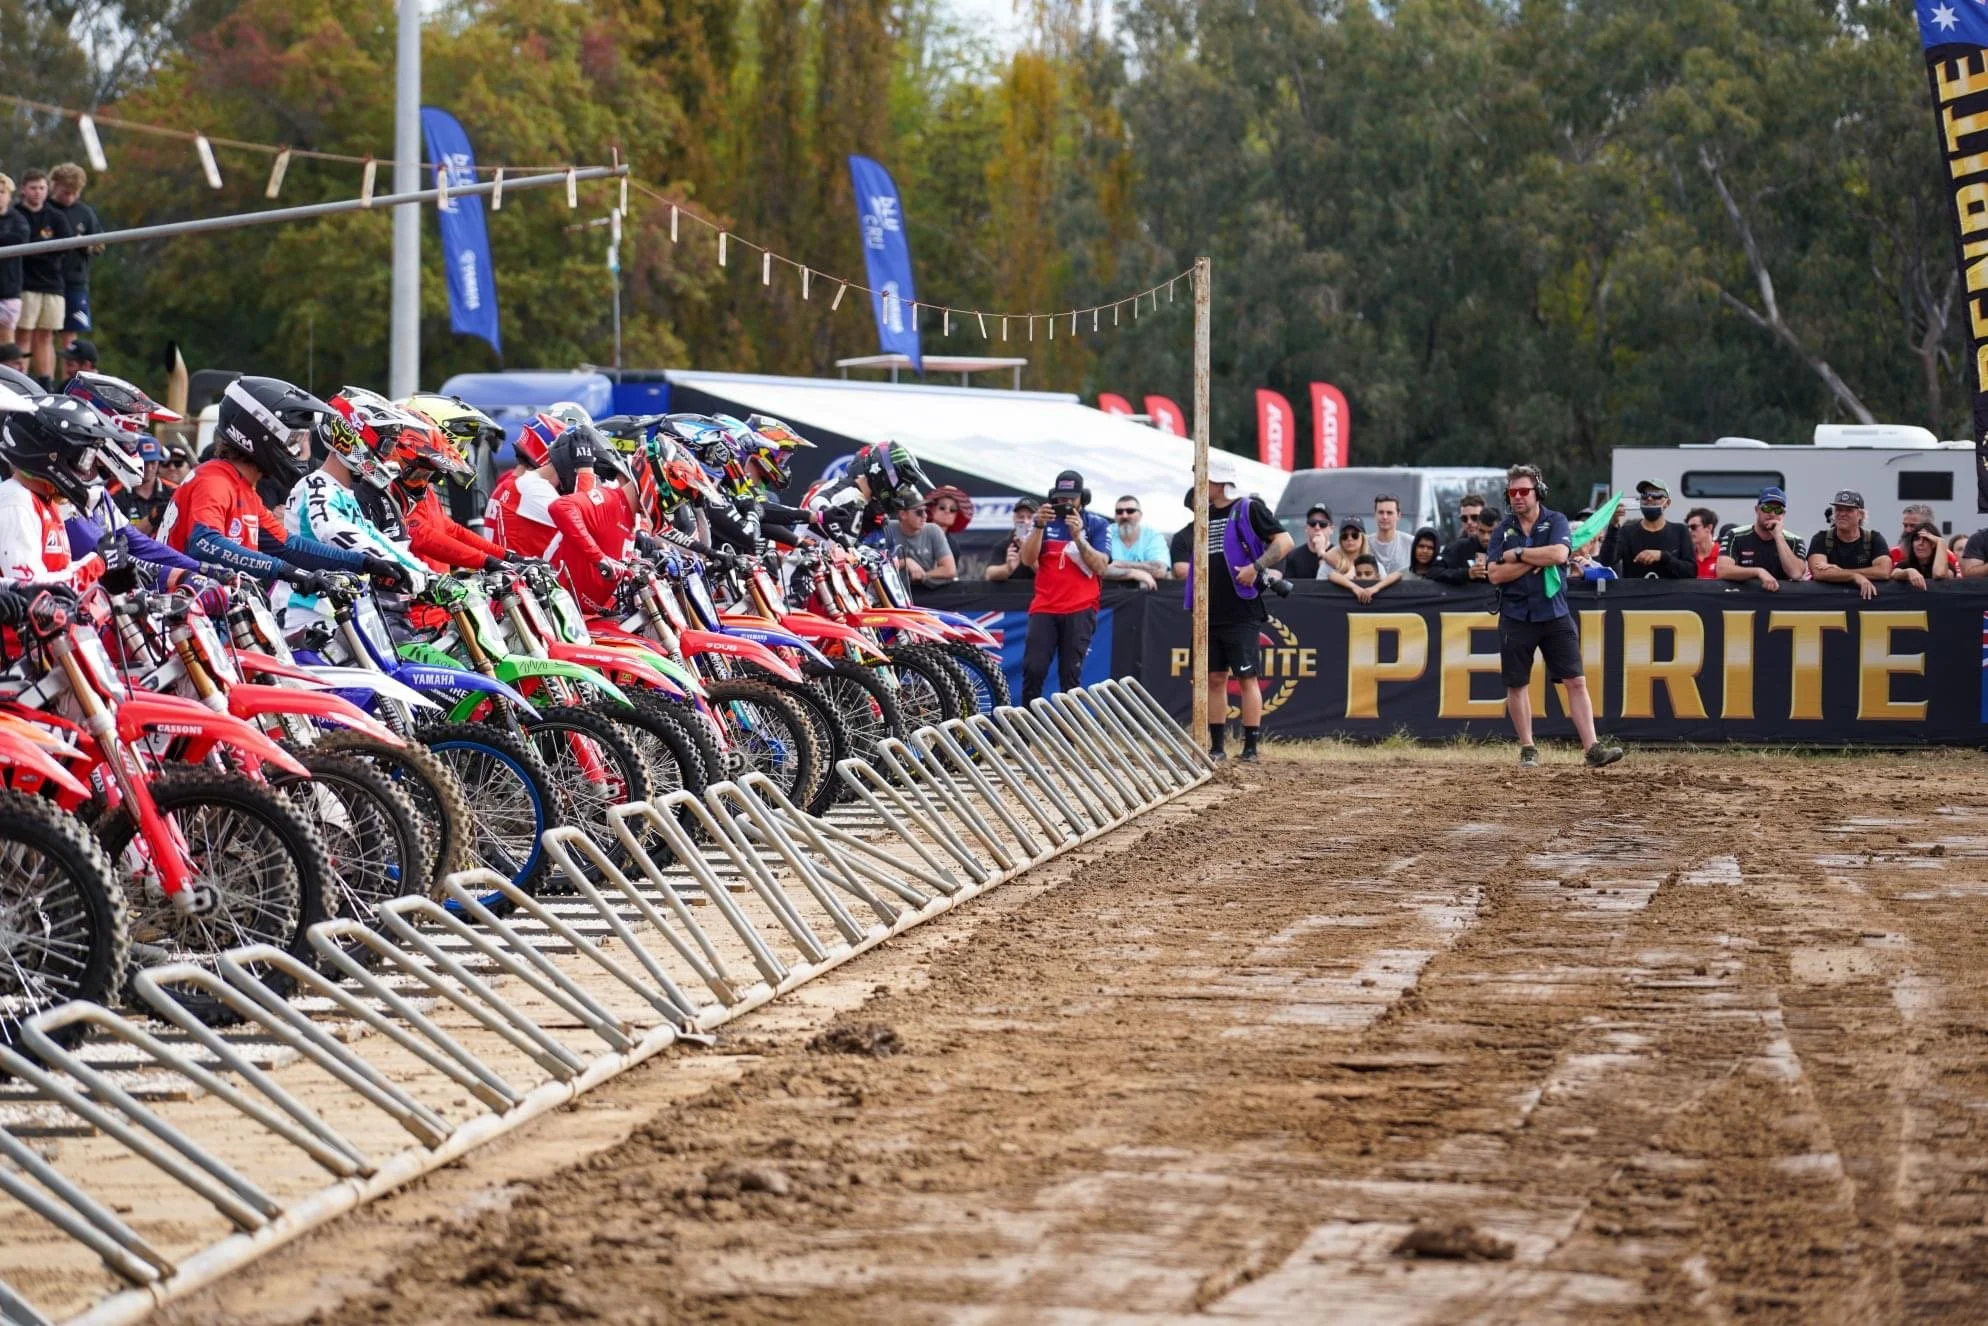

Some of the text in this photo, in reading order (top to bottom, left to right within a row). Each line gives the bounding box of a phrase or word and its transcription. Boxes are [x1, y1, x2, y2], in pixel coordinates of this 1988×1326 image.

[1935, 49, 1988, 394] RITE
[576, 446, 592, 457] FLY
[104, 549, 118, 569] FLY
[196, 538, 273, 573] FLY RACING
[1170, 648, 1317, 677] PITE
[1346, 610, 1929, 721] PENRITE
[412, 673, 455, 686] YAMAHA
[157, 724, 203, 735] CASSONS
